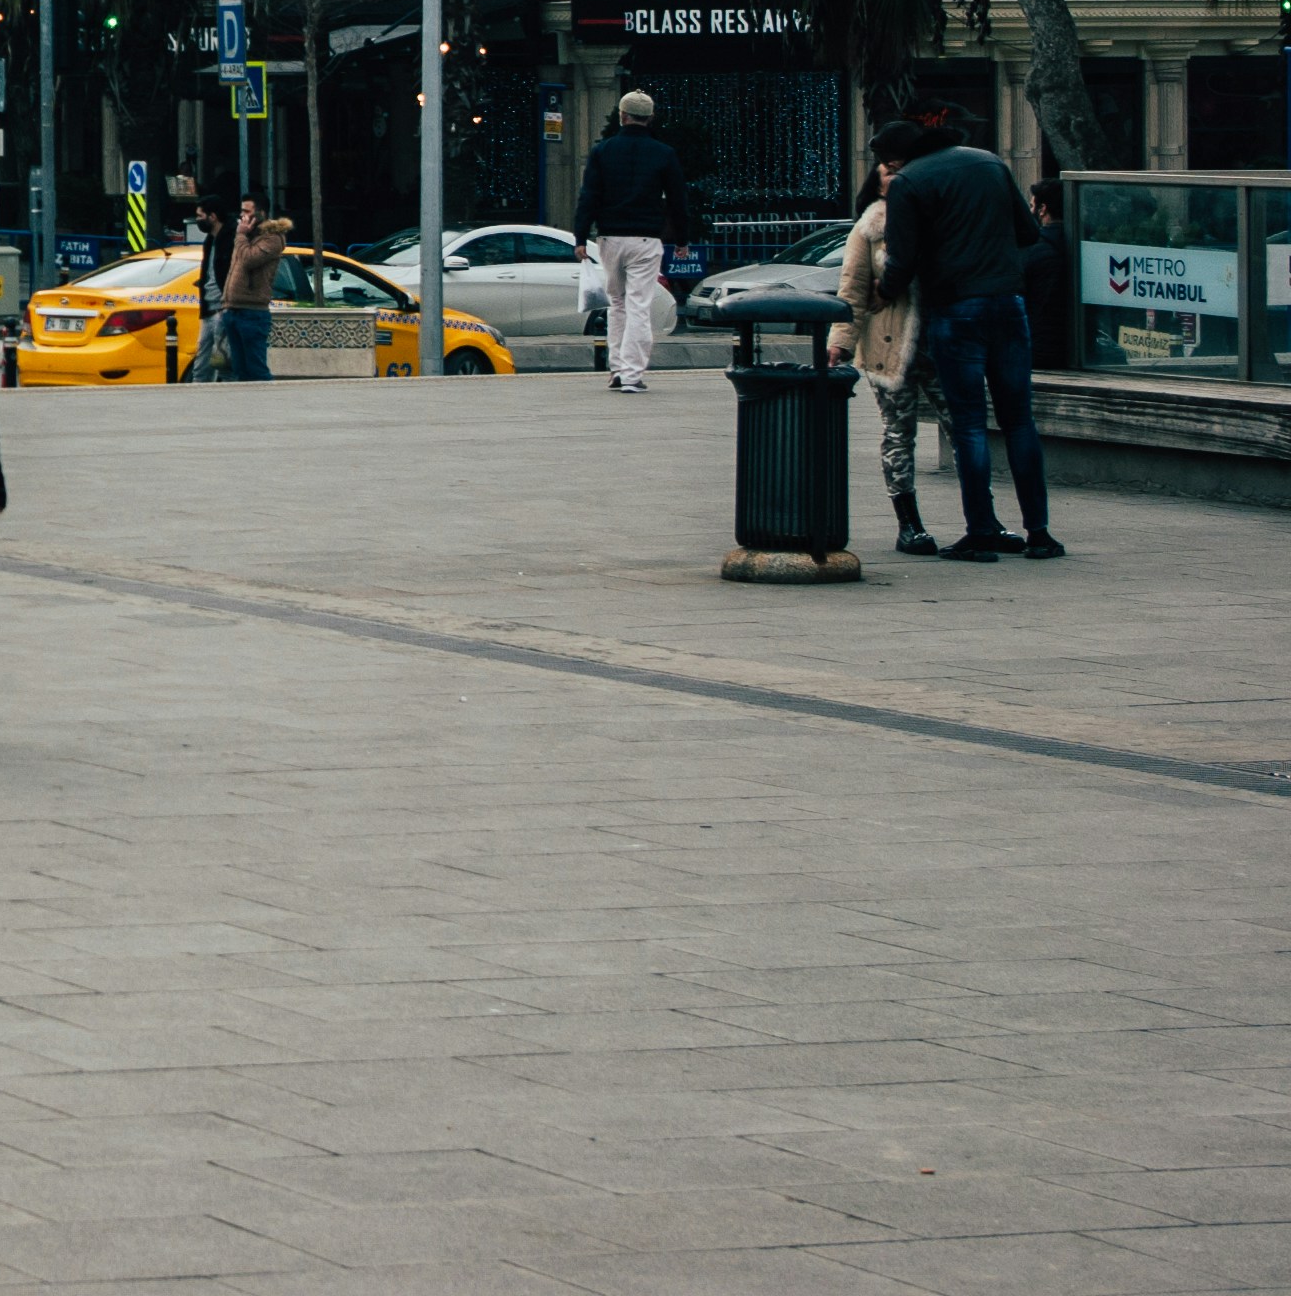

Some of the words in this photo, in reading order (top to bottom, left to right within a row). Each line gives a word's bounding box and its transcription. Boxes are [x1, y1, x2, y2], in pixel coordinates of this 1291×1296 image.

[55, 254, 94, 264] ZBITA
[668, 264, 702, 274] ZABITA
[1133, 257, 1186, 277] METRO
[1133, 276, 1207, 302] İSTANBUL
